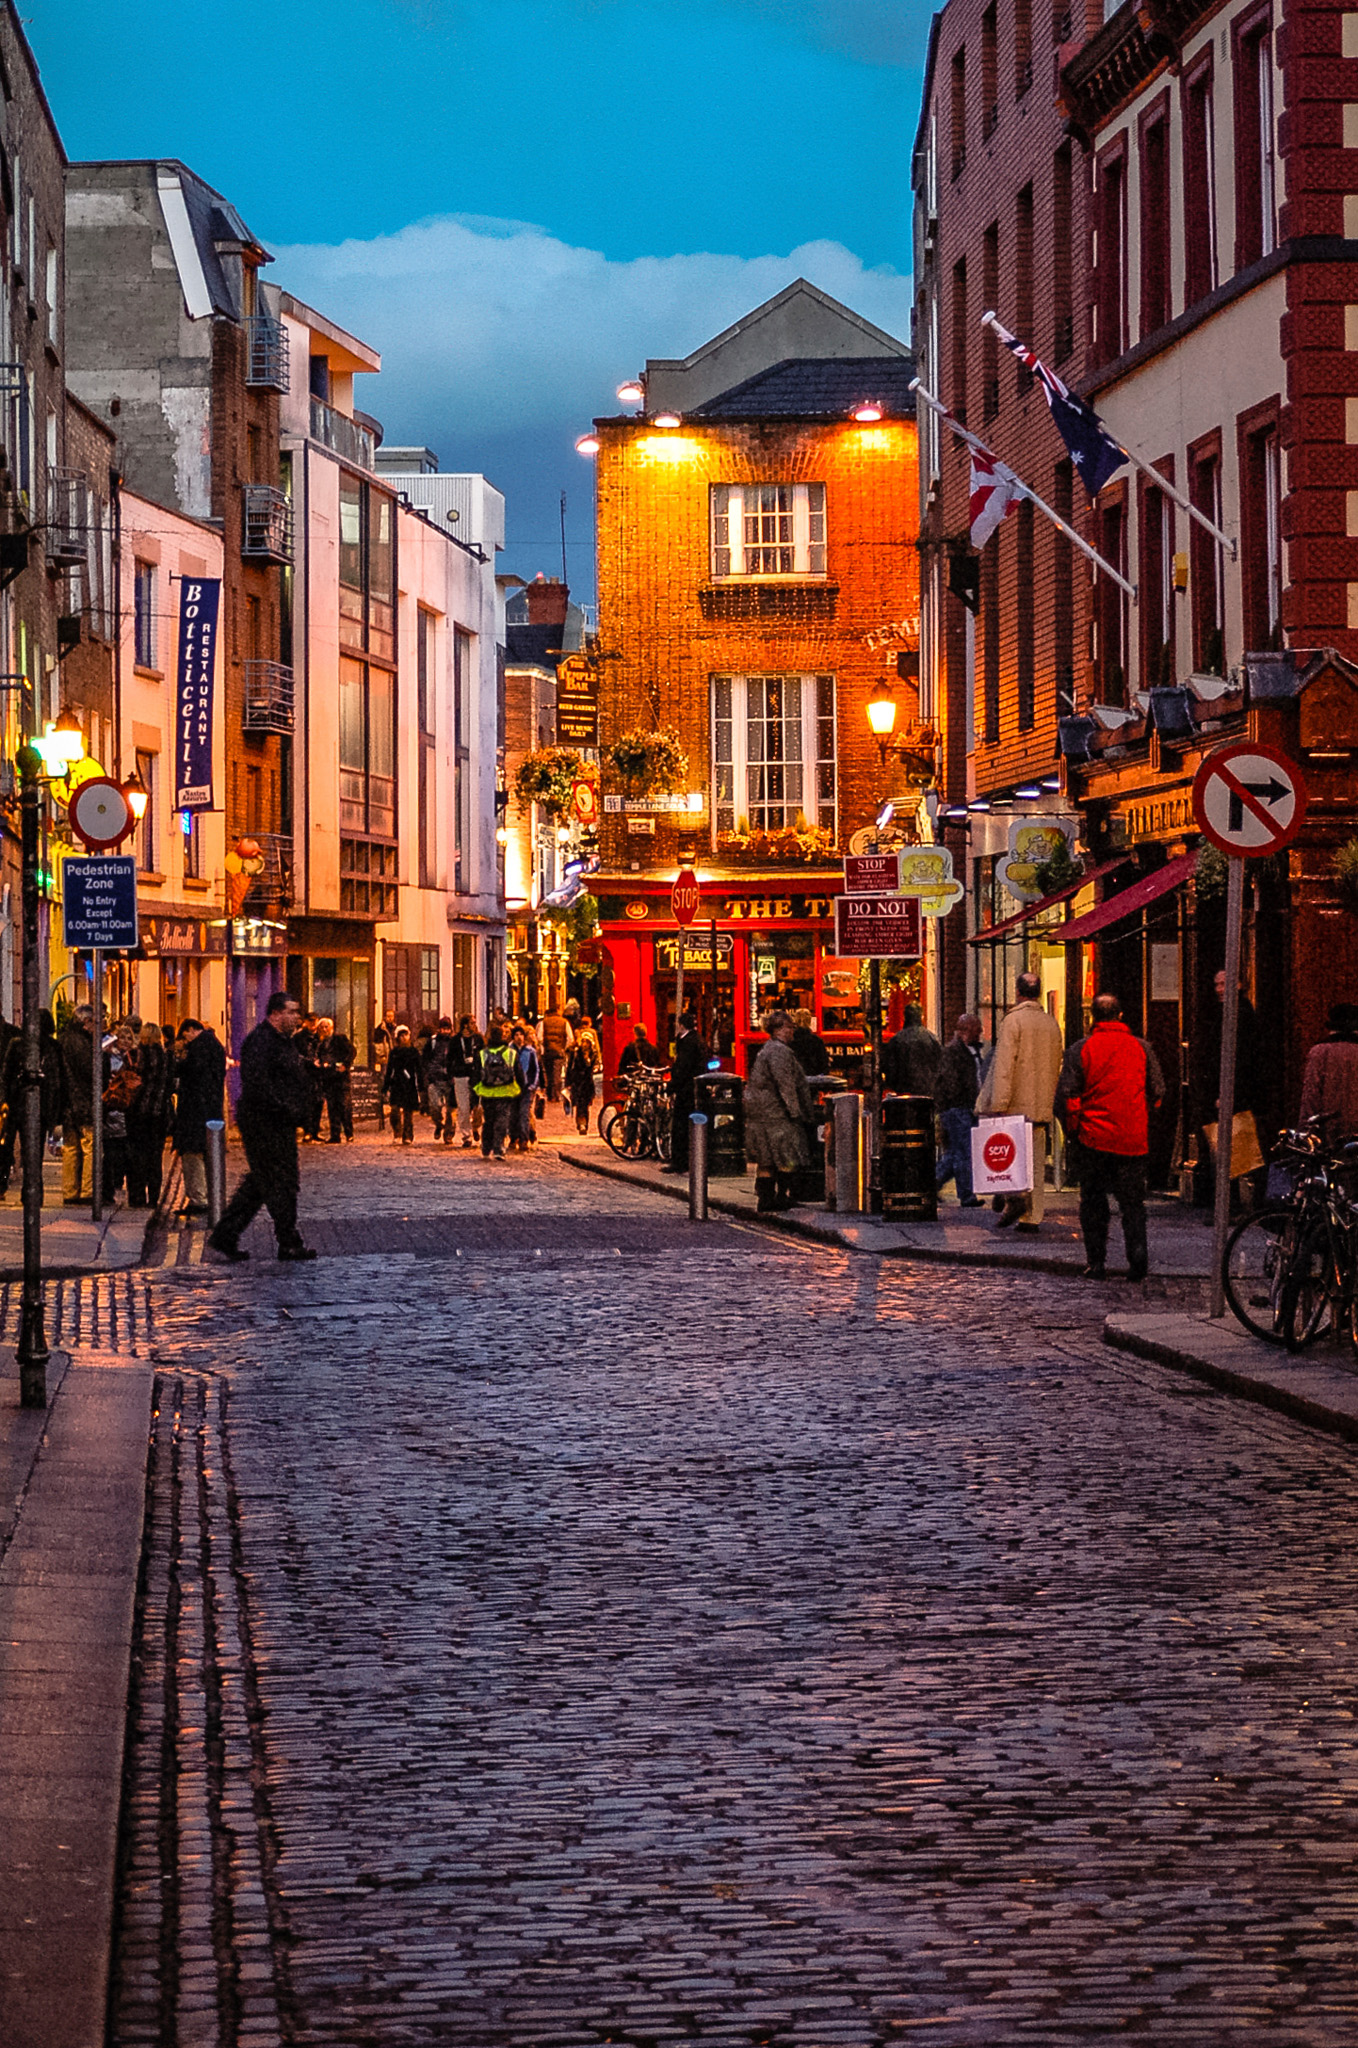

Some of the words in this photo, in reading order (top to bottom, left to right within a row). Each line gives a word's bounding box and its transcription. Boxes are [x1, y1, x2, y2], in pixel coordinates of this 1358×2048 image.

[569, 660, 585, 669] THE
[557, 665, 597, 681] TEMPLE
[182, 584, 202, 785] Botticelli
[198, 623, 211, 745] RESTAURANT
[566, 679, 589, 691] BAR
[67, 863, 131, 876] Pedestrian
[857, 859, 886, 870] STOP
[85, 877, 114, 889] Zone
[82, 896, 94, 905] No
[96, 896, 117, 907] Entry
[674, 887, 697, 909] STOP
[86, 908, 112, 918] Except
[724, 899, 792, 919] THE
[849, 902, 871, 915] DO
[877, 901, 910, 915] NOT
[87, 932, 92, 940] 7
[94, 932, 113, 942] Days
[988, 1145, 1011, 1157] sexy
